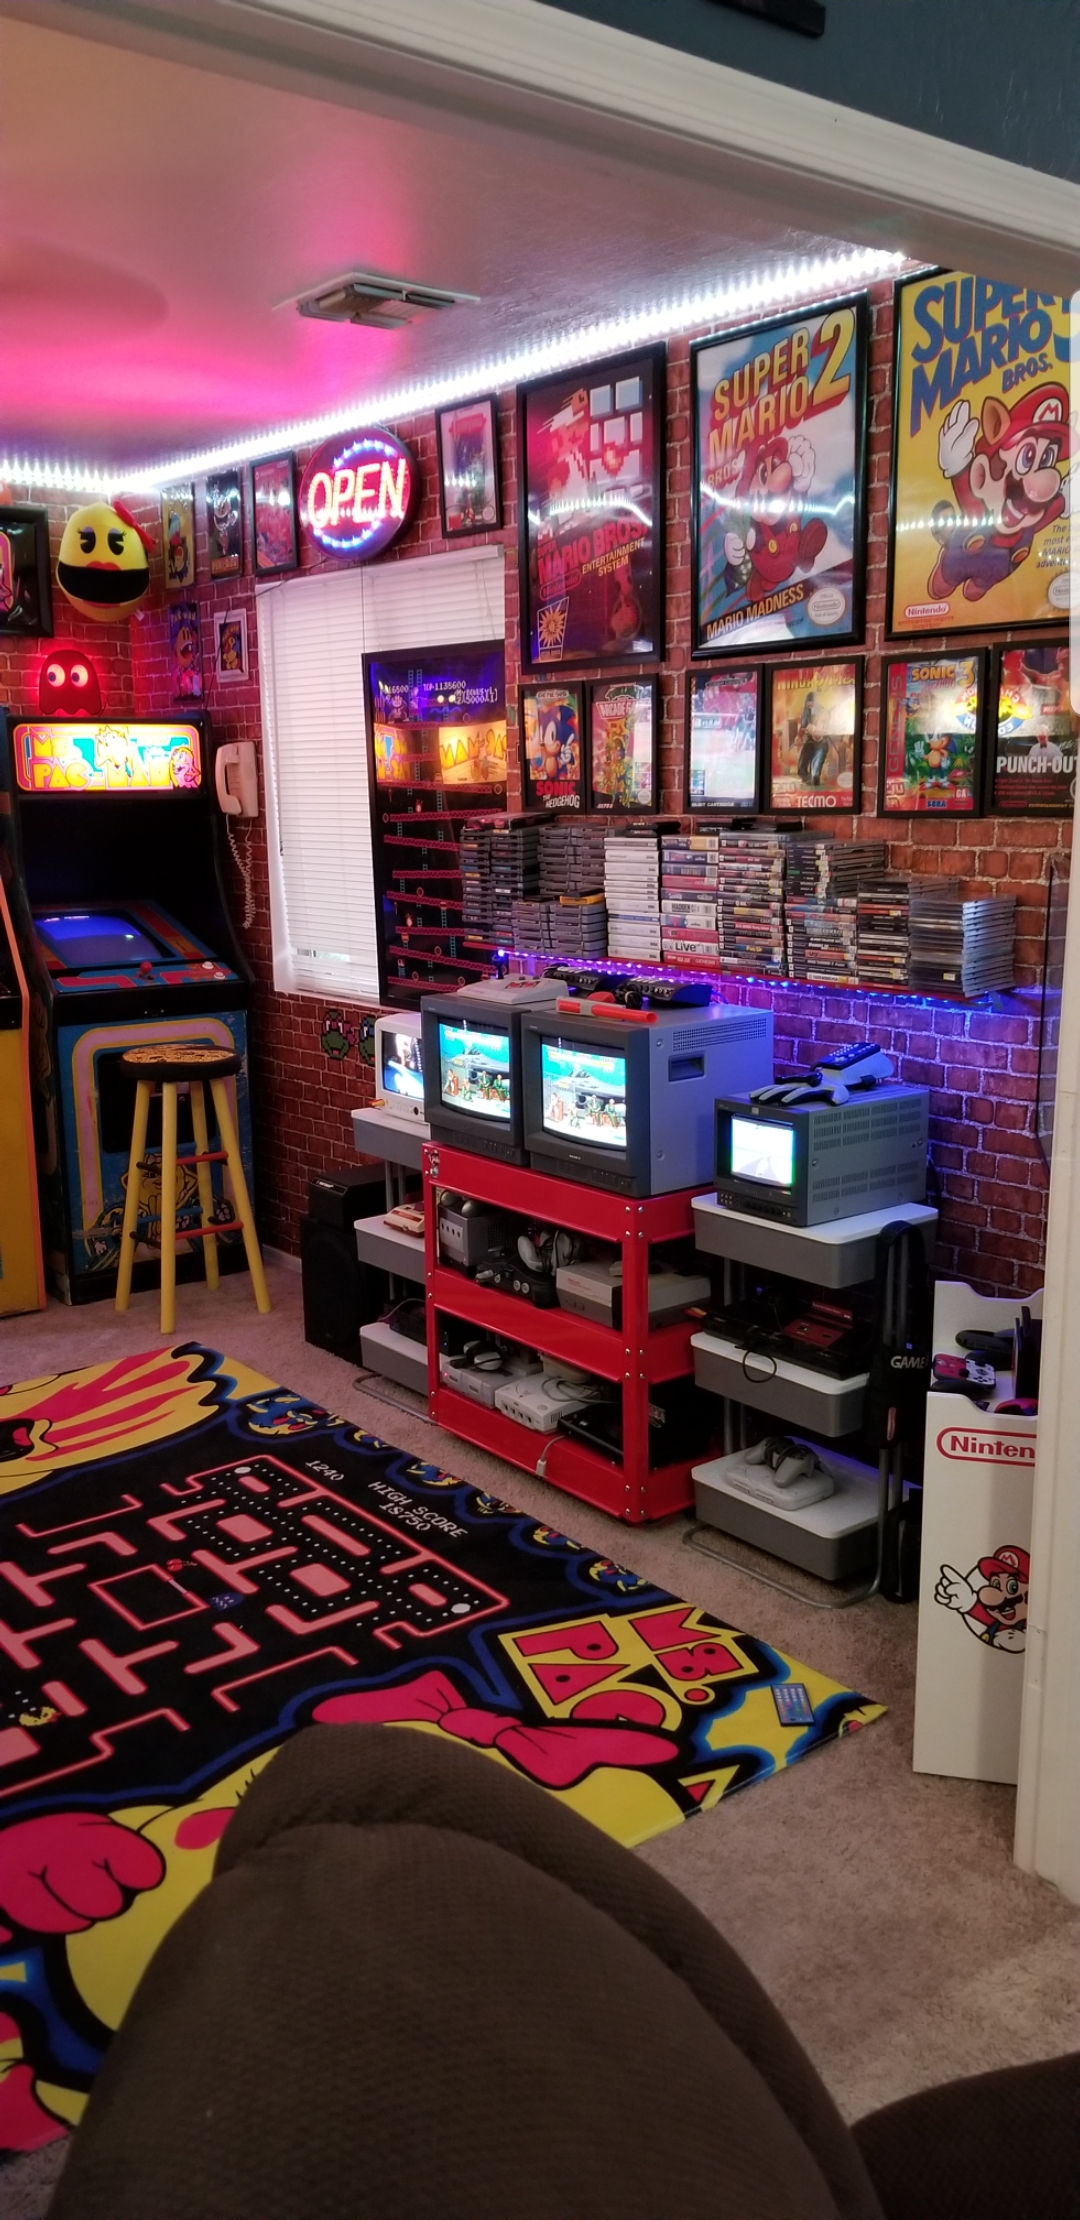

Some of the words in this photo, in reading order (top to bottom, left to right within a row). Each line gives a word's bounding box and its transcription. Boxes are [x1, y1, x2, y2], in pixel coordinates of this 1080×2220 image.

[713, 327, 810, 421] SUPER
[819, 308, 856, 407] 2
[910, 308, 1053, 438] MARIO
[1002, 352, 1054, 394] BROS.
[708, 375, 810, 467] MARIO
[307, 457, 407, 529] OPEN
[538, 536, 591, 585] MARIO
[593, 517, 648, 558] BROS.
[582, 537, 646, 575] ENTERTAINMENT
[1043, 536, 1064, 545] most
[598, 555, 629, 577] SYSTEM
[706, 611, 745, 641] MARIO
[746, 583, 805, 623] MADNESS
[908, 604, 947, 616] Nintendo
[911, 665, 956, 682] SONIC
[957, 660, 976, 689] 3
[889, 675, 901, 772] GENESIS
[536, 780, 576, 796] SONIC
[545, 795, 580, 808] HEDGEHOG
[797, 795, 837, 808] TECMO
[304, 1460, 345, 1481] 1240
[367, 1481, 413, 1506] HIGH
[412, 1505, 468, 1538] SCORE
